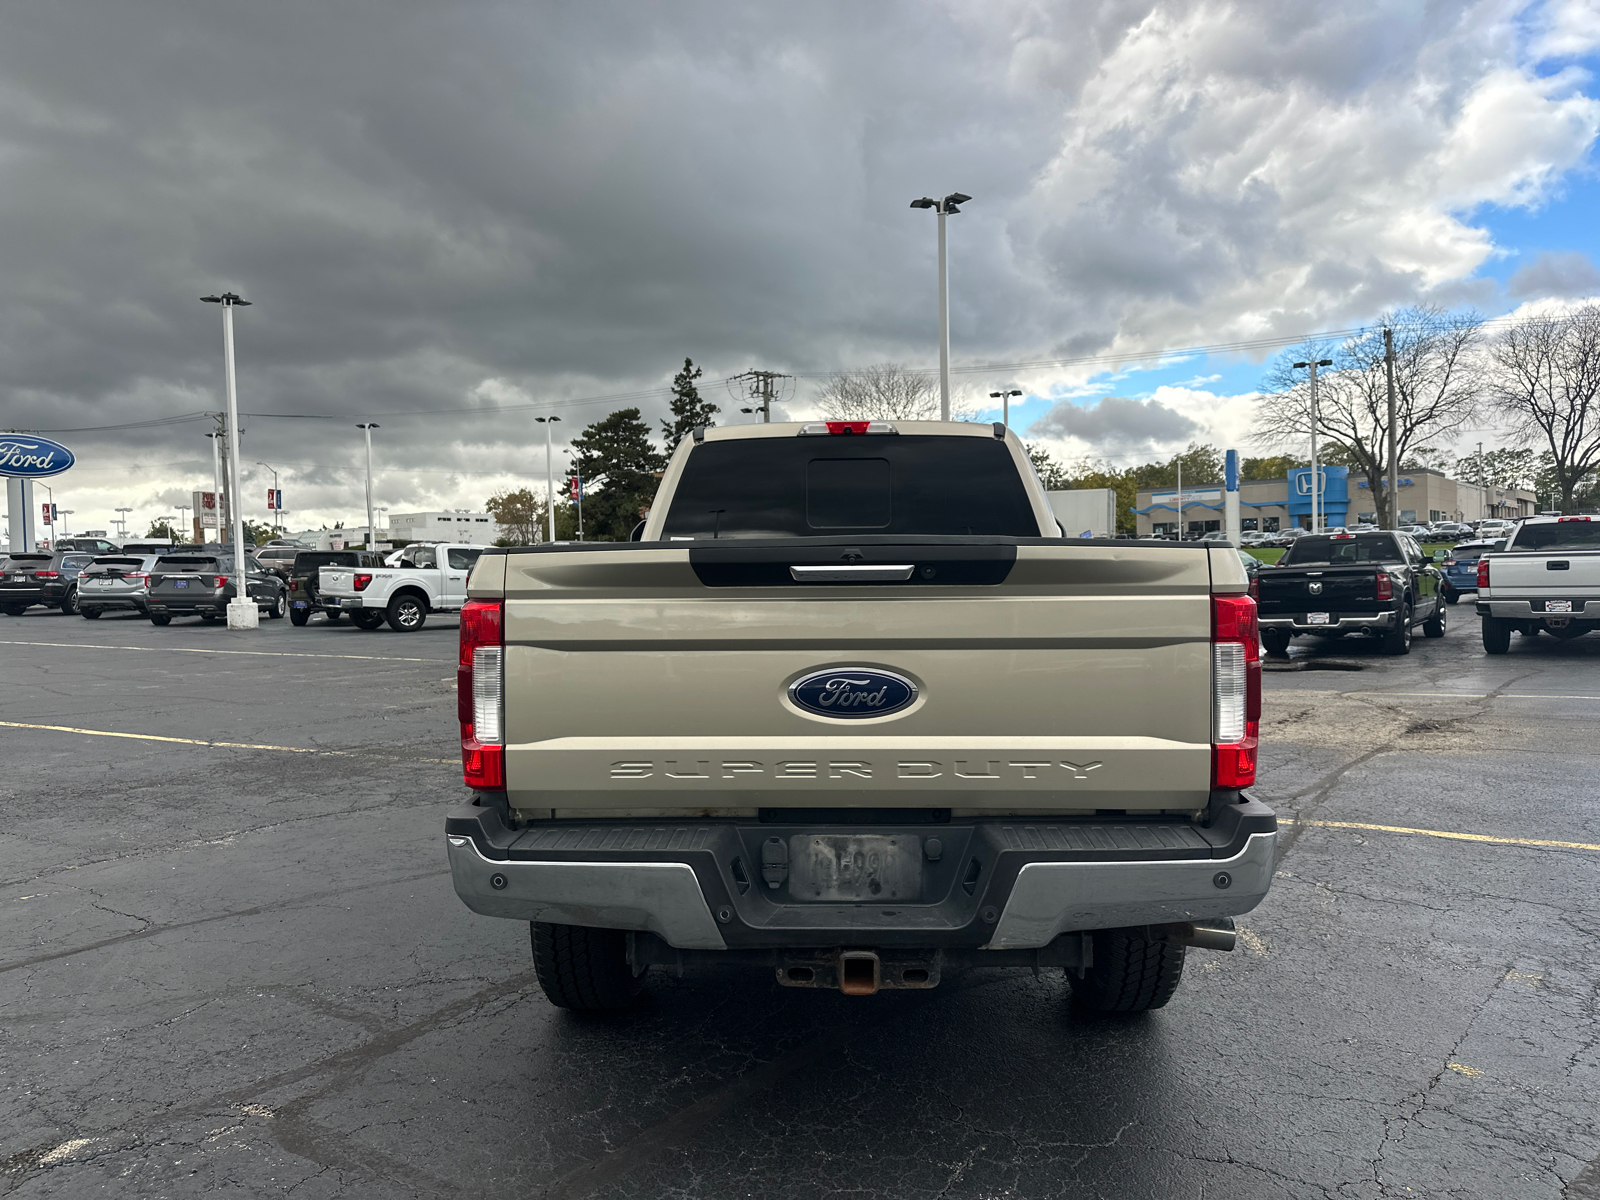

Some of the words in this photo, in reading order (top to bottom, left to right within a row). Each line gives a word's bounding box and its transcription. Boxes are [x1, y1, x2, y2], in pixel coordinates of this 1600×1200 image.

[0, 441, 54, 469] Ford
[818, 678, 888, 707] Ford
[610, 760, 873, 779] SUPER
[897, 760, 1103, 779] DUTY
